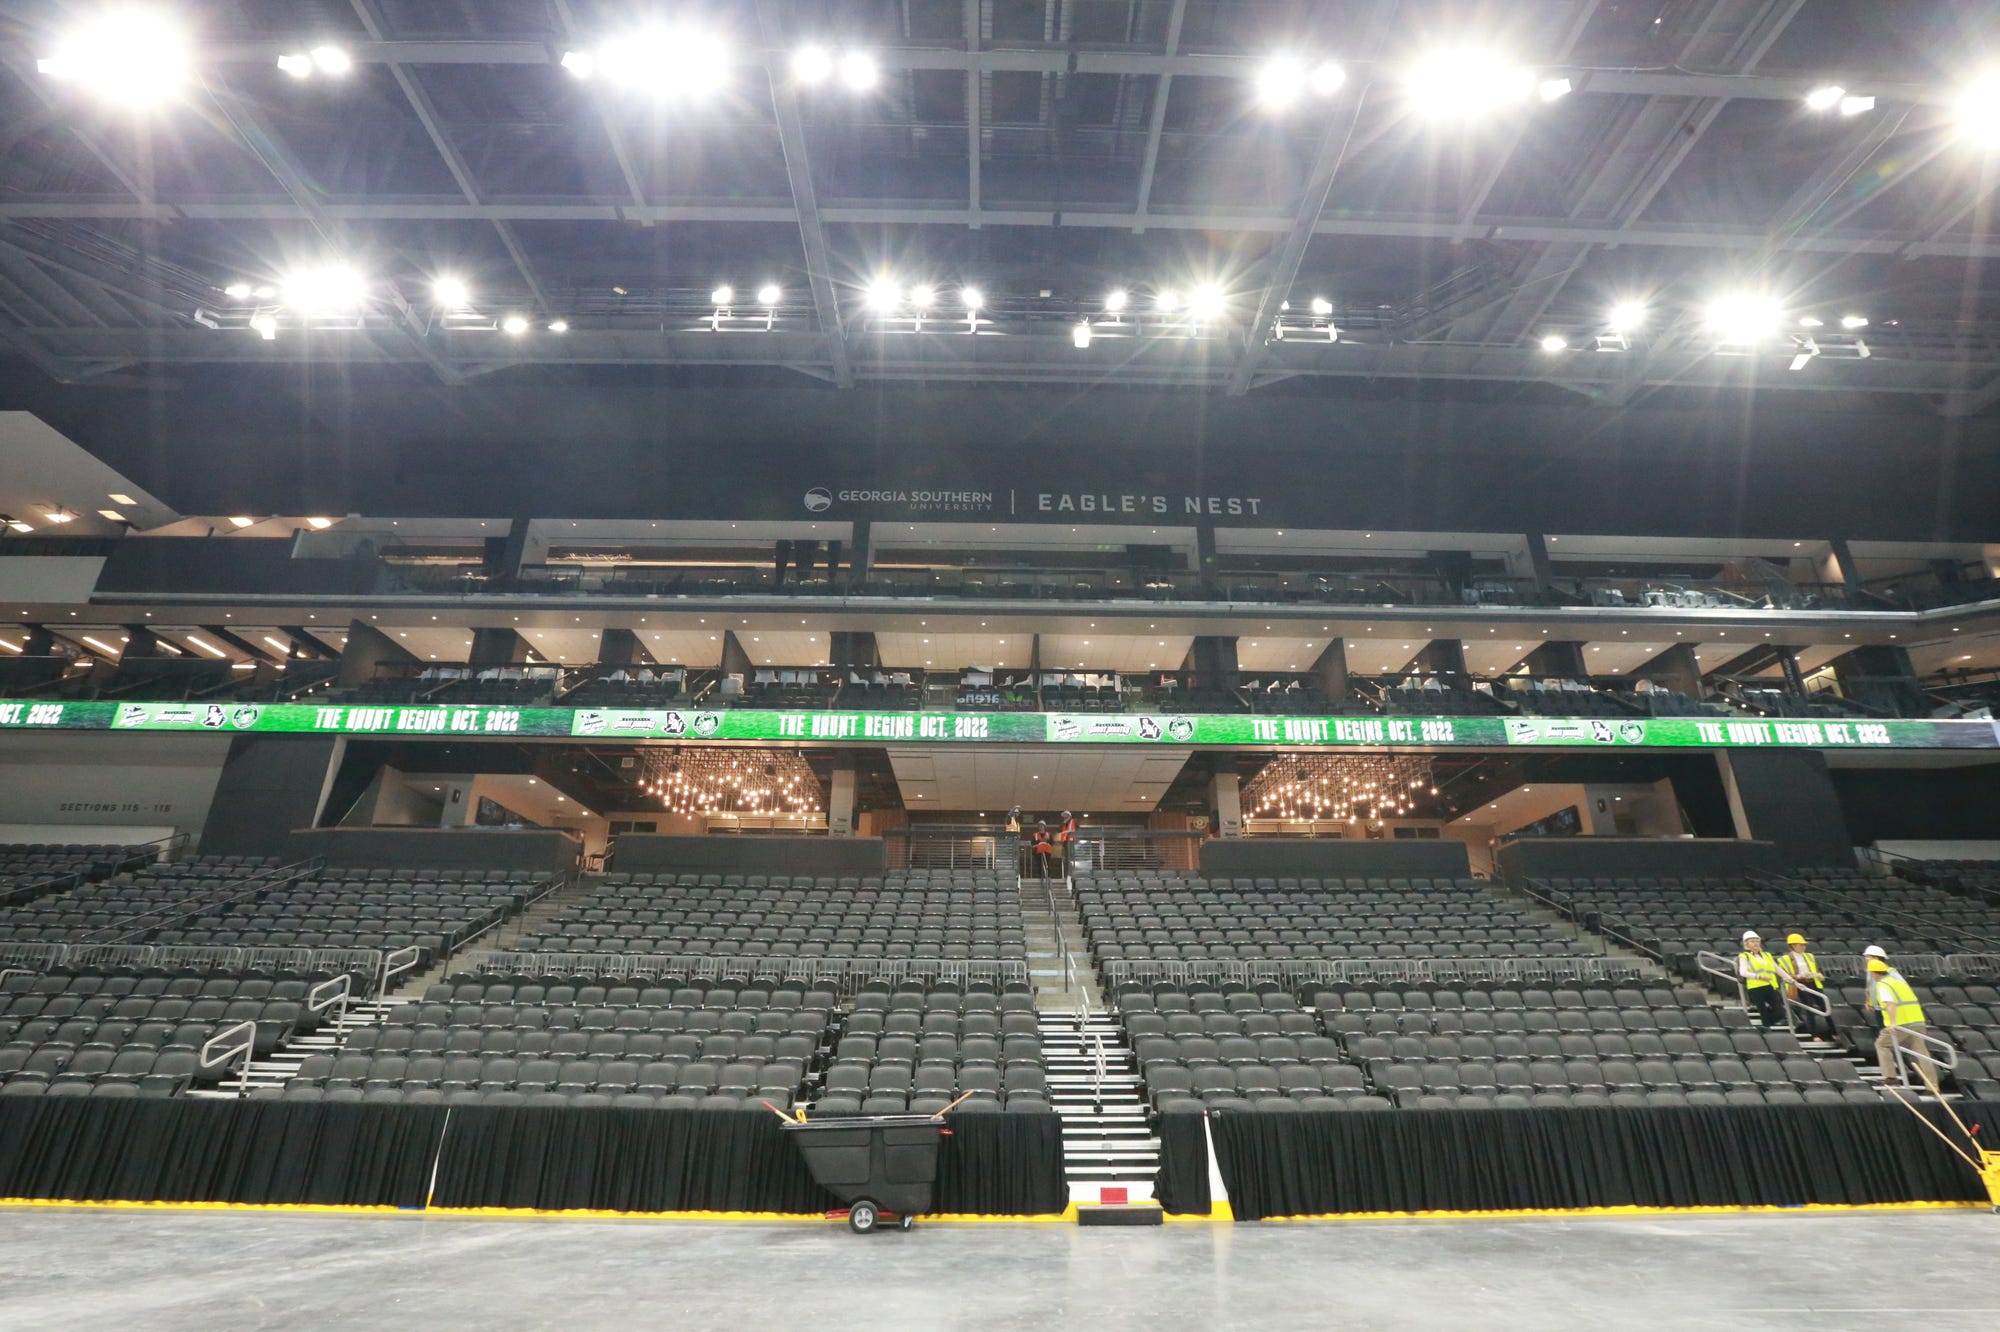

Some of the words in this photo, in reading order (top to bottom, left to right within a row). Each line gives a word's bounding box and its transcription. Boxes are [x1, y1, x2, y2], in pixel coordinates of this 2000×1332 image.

[838, 490, 906, 502] GEORGIA
[911, 490, 992, 503] SOUTHERN
[910, 503, 992, 511] UNIVERSITY
[1038, 493, 1167, 512] EAGLE'S
[1185, 496, 1261, 515] NEST
[26, 704, 64, 725] 2022
[315, 708, 342, 729] THE
[346, 708, 394, 731] HAUNT
[397, 709, 448, 732] BEGINS
[451, 710, 480, 731] OCT.
[485, 711, 520, 732] 2022
[778, 715, 805, 736] THE
[811, 715, 859, 738] HAUNT
[864, 715, 913, 739] BEGINS
[920, 716, 948, 737] OCT.
[955, 717, 988, 738] 2022
[1251, 719, 1280, 740] THE
[1284, 720, 1329, 743] HAUNT
[1335, 720, 1384, 743] BEGINS
[1387, 720, 1417, 741] OCT.
[1421, 721, 1455, 742] 2022
[1696, 723, 1726, 743] THE
[1726, 723, 1772, 745] HAUNT
[1774, 723, 1824, 745] BEGINS
[1824, 723, 1856, 743] OCT.
[1855, 724, 1891, 744] 2022
[60, 803, 117, 812] SECTIONS
